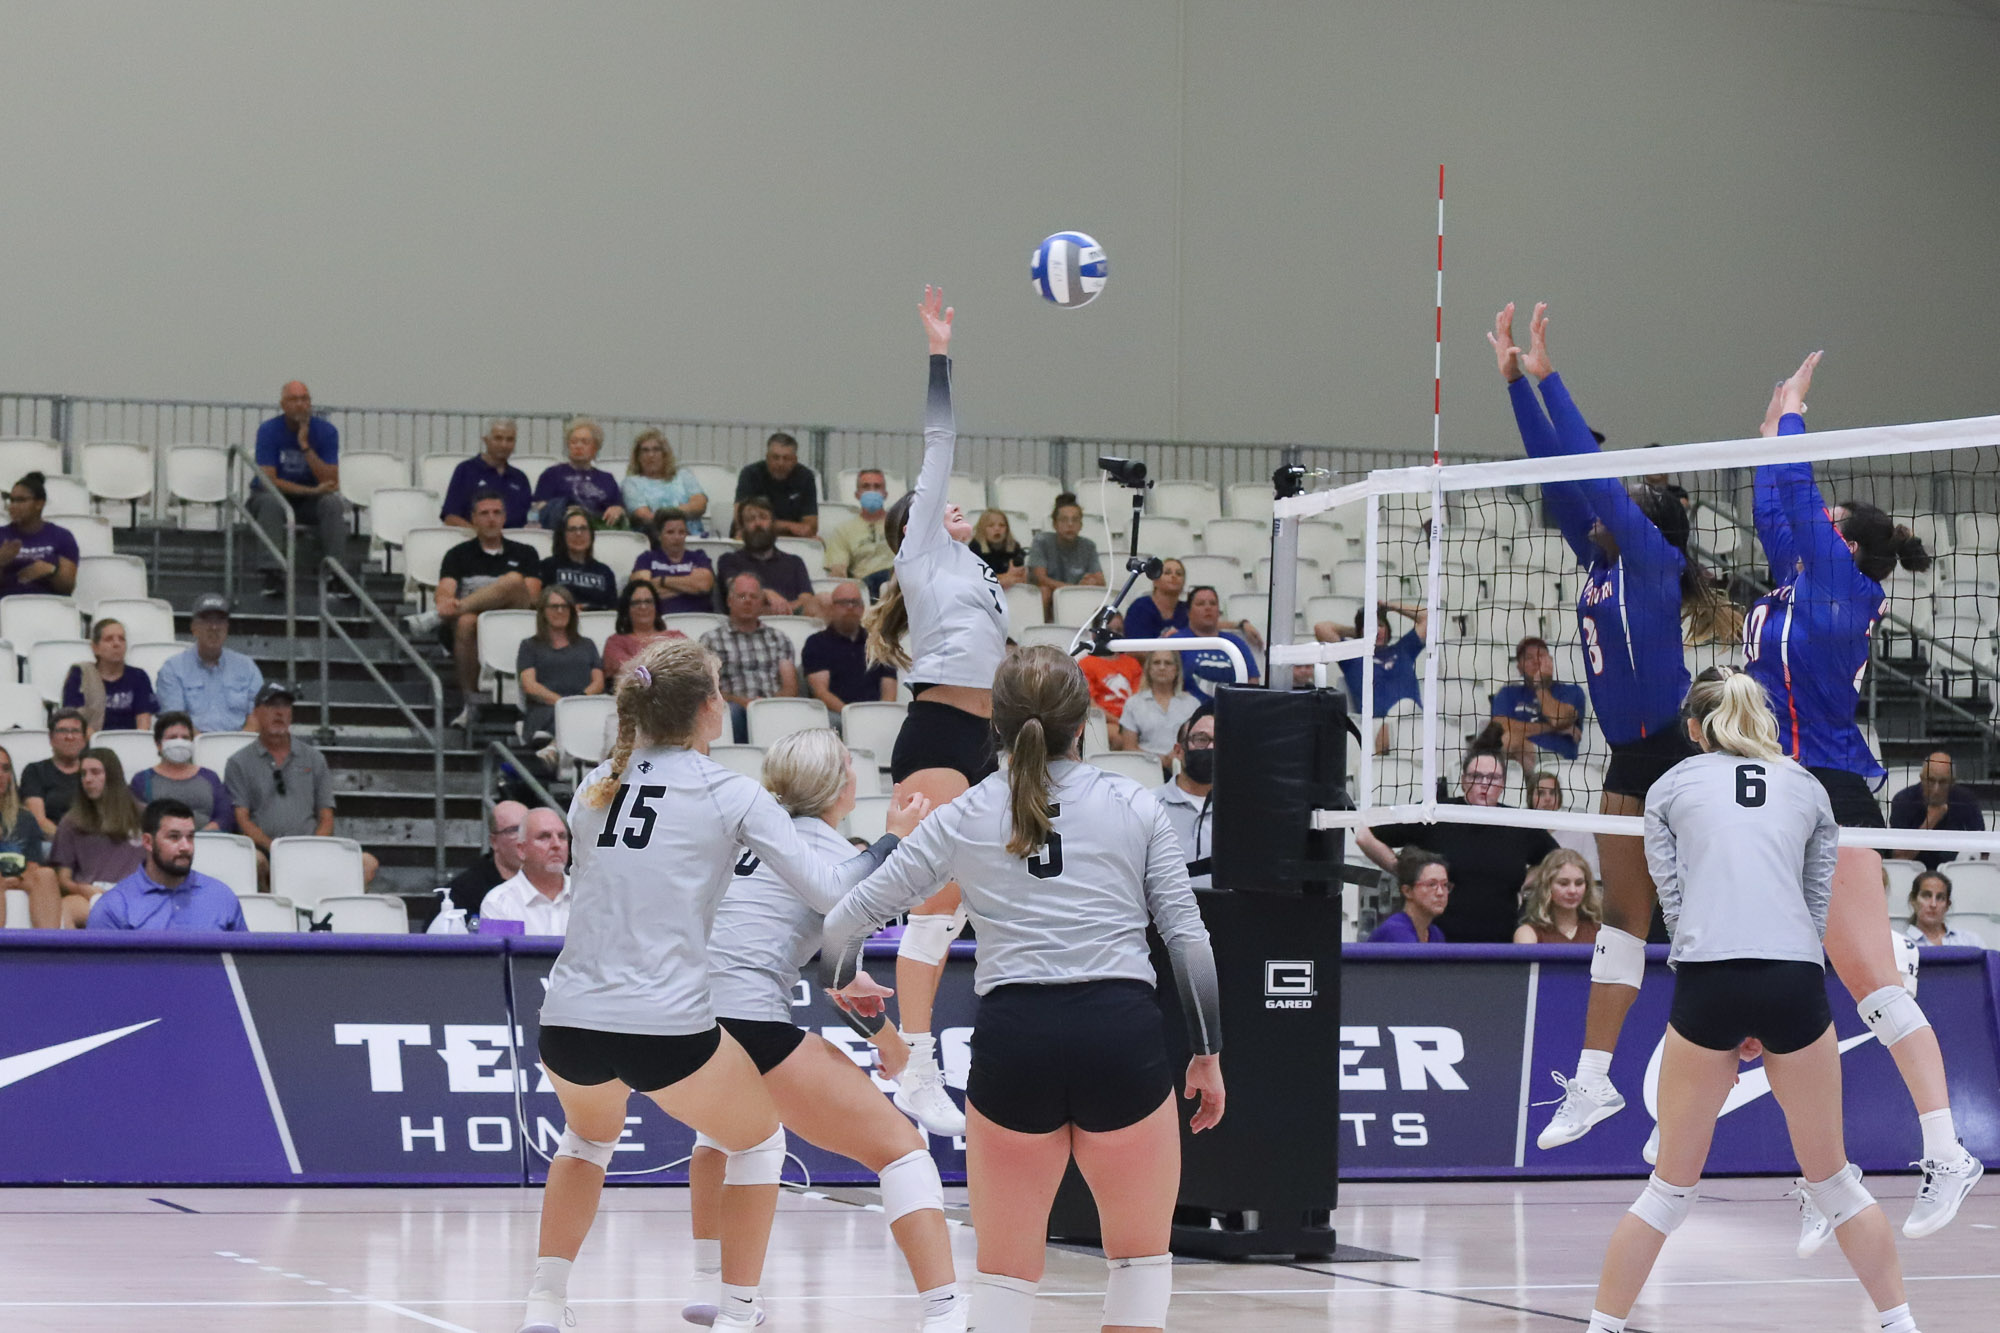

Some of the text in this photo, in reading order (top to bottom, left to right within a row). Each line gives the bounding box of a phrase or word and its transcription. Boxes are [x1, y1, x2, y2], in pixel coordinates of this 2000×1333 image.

[1734, 763, 1767, 808] 6
[595, 783, 668, 850] 15
[1265, 999, 1312, 1009] GARED
